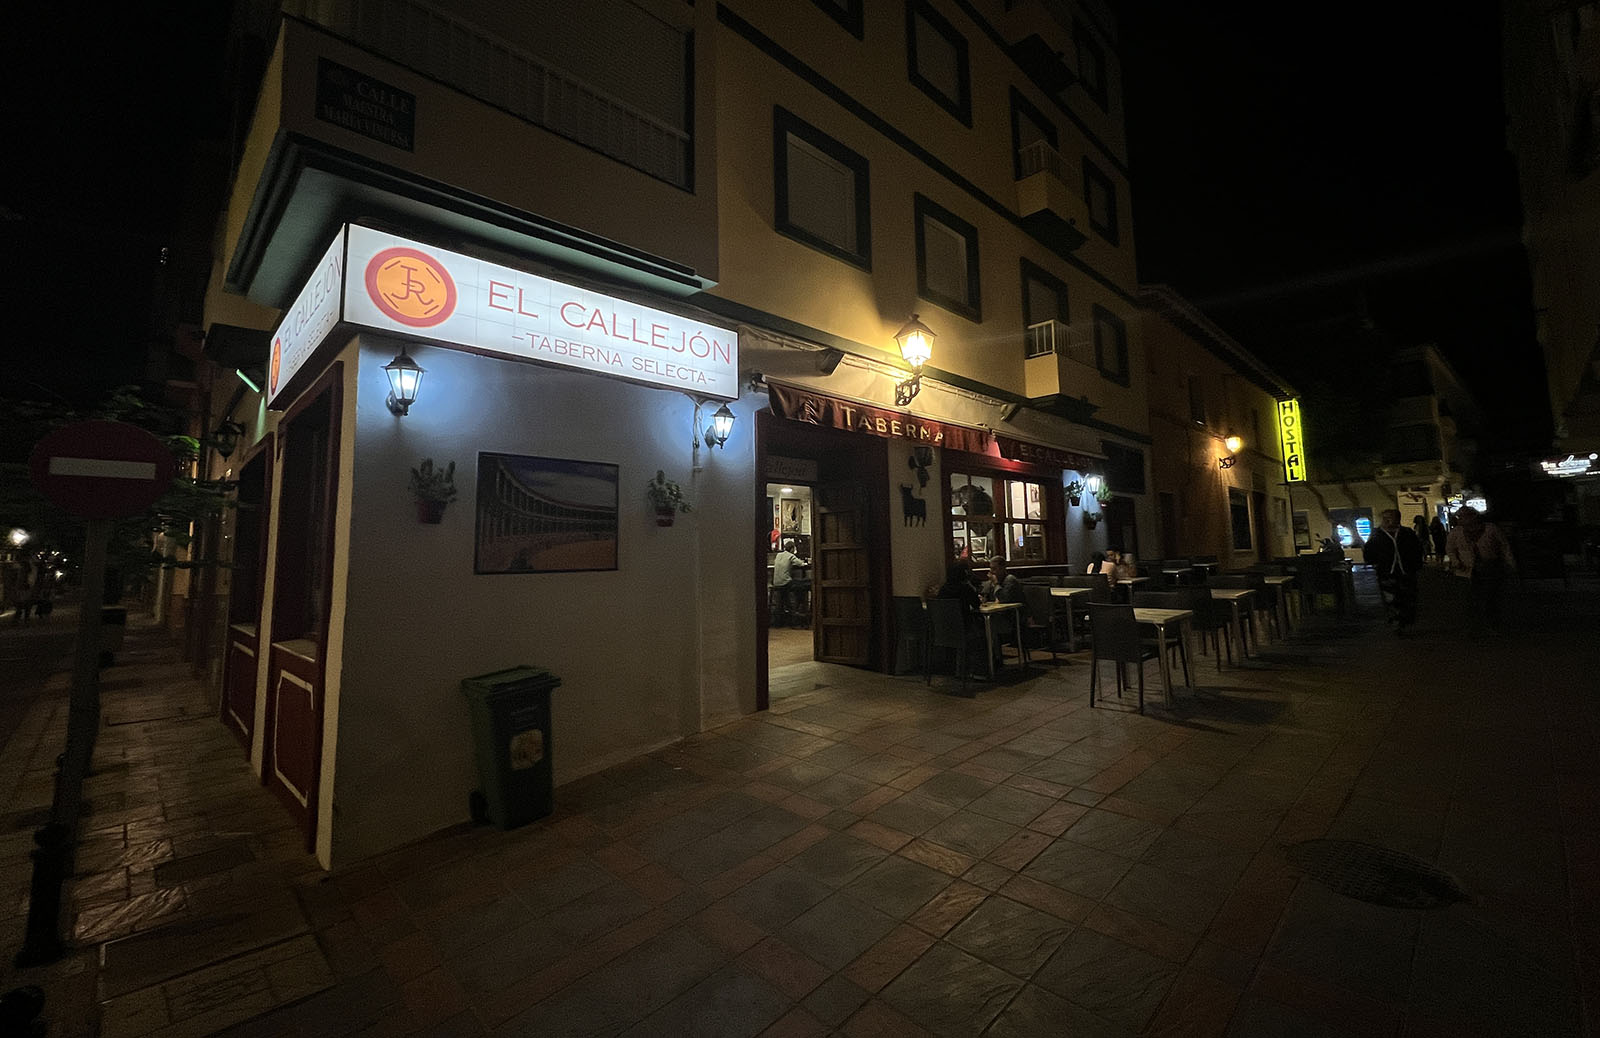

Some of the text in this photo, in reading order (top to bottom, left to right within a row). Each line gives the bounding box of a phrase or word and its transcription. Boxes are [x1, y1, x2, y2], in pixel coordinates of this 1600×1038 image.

[356, 79, 409, 114] CALLE
[487, 279, 732, 366] EL CALLEJÓN
[1281, 401, 1300, 481] HOSTAL
